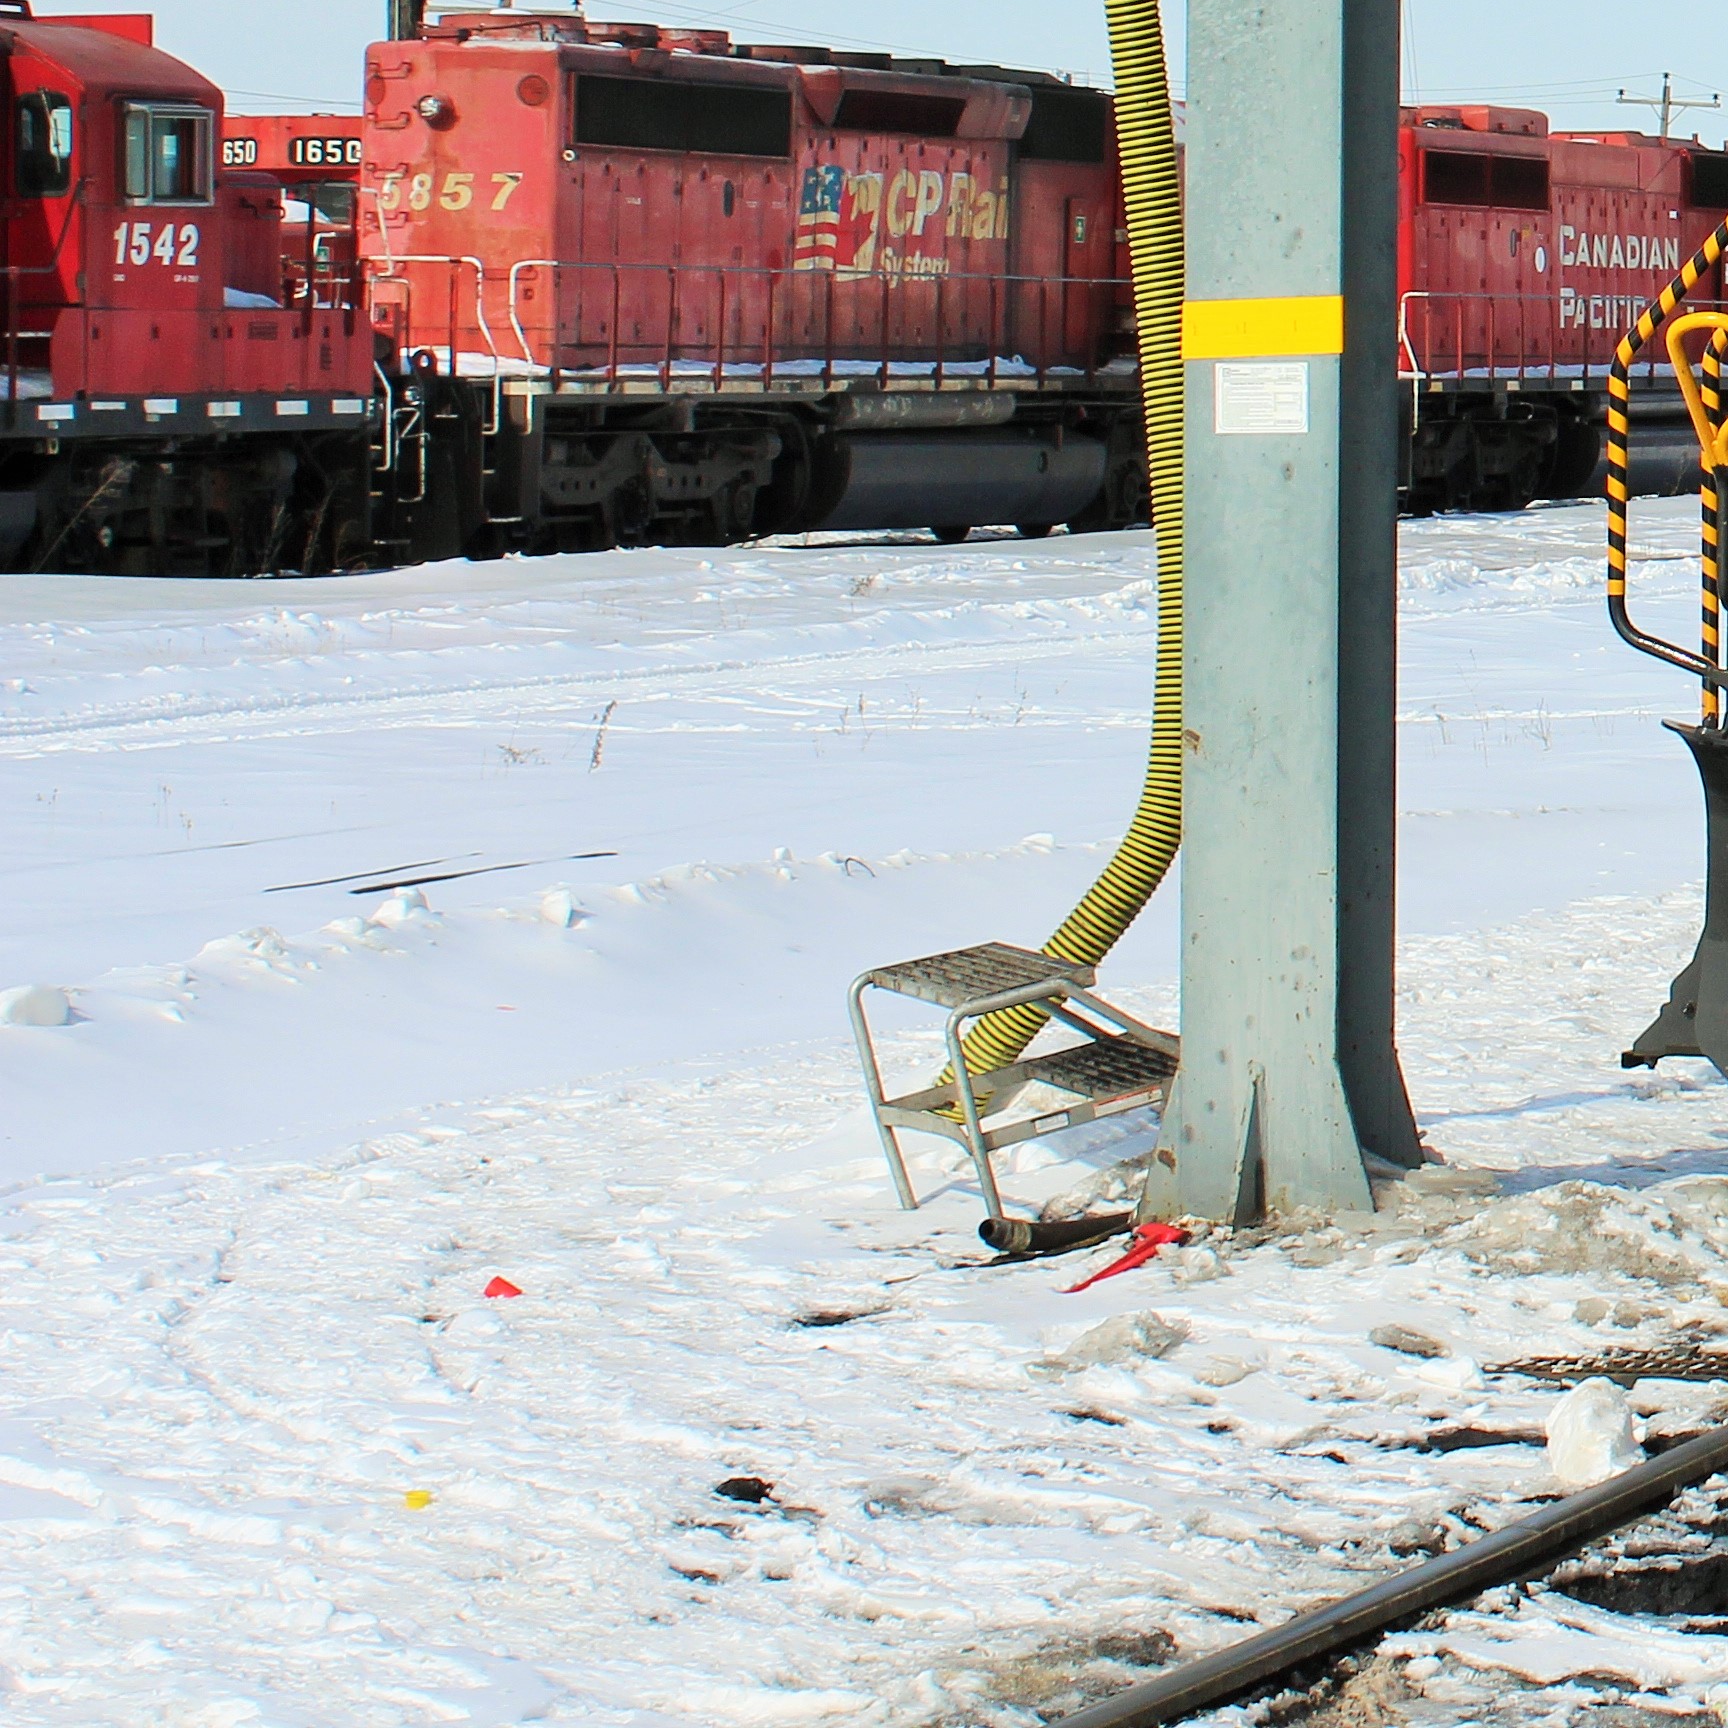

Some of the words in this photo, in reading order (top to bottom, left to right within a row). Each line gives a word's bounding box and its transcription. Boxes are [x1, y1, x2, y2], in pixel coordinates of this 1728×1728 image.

[222, 140, 257, 165] 650
[295, 139, 362, 164] 1650
[381, 171, 524, 211] 5857
[886, 168, 944, 239] CP
[113, 222, 200, 266] 1542
[1560, 224, 1680, 271] CANADIAN
[879, 246, 950, 290] System
